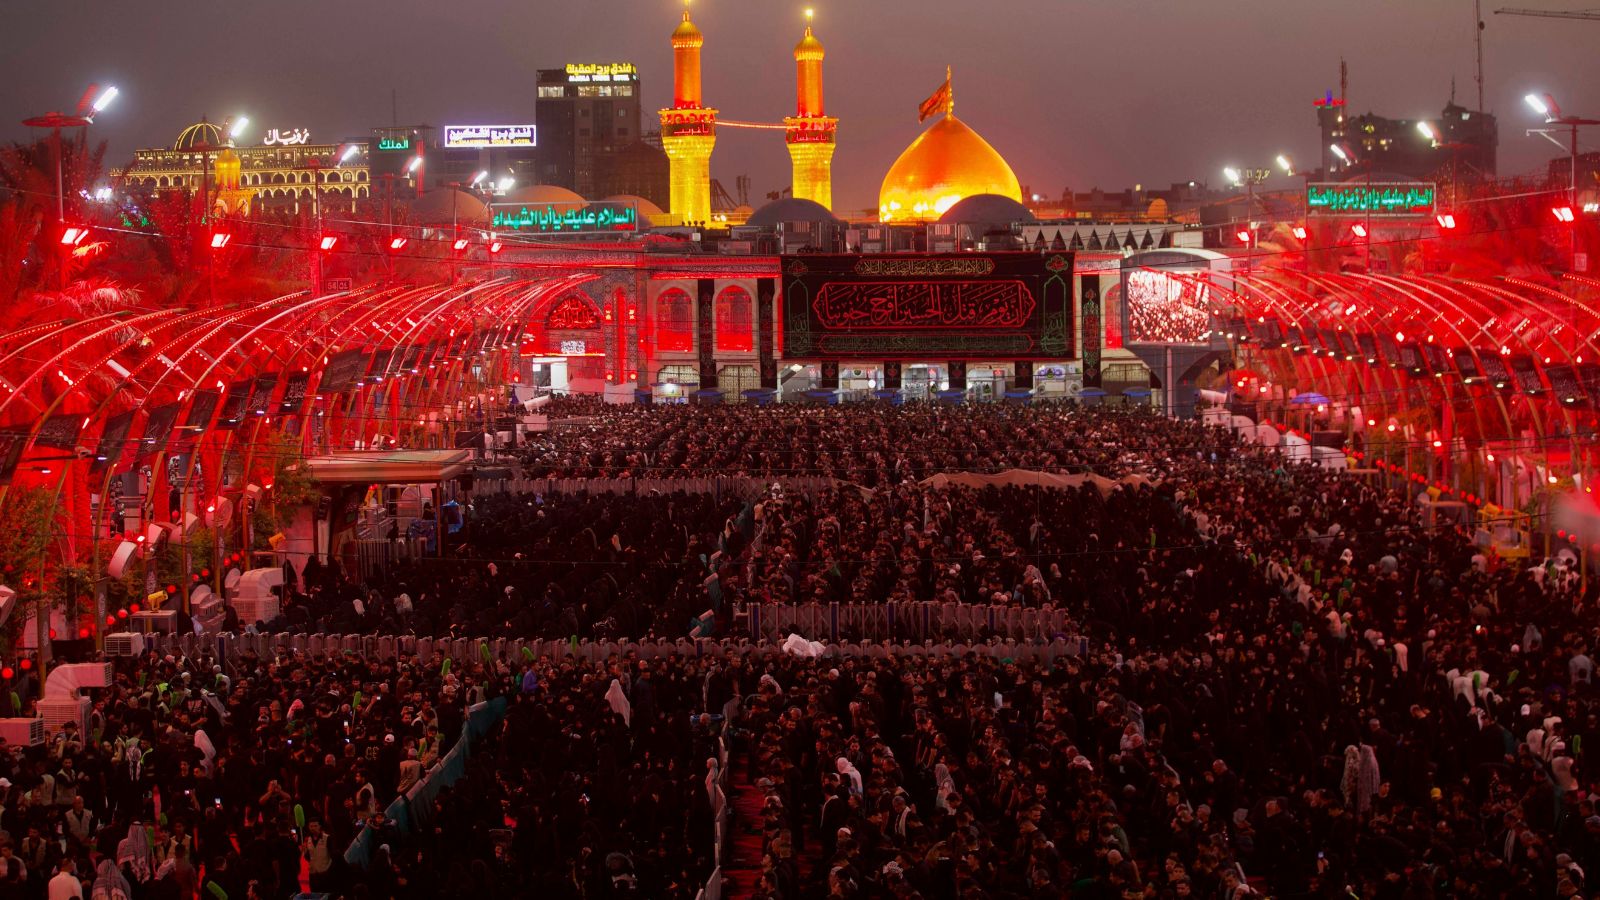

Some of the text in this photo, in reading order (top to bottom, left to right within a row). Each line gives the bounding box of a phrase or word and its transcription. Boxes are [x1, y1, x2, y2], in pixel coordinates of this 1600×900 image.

[611, 63, 632, 75] فندق
[378, 138, 409, 150] الملك
[563, 207, 596, 230] عليك
[596, 207, 635, 229] السلام
